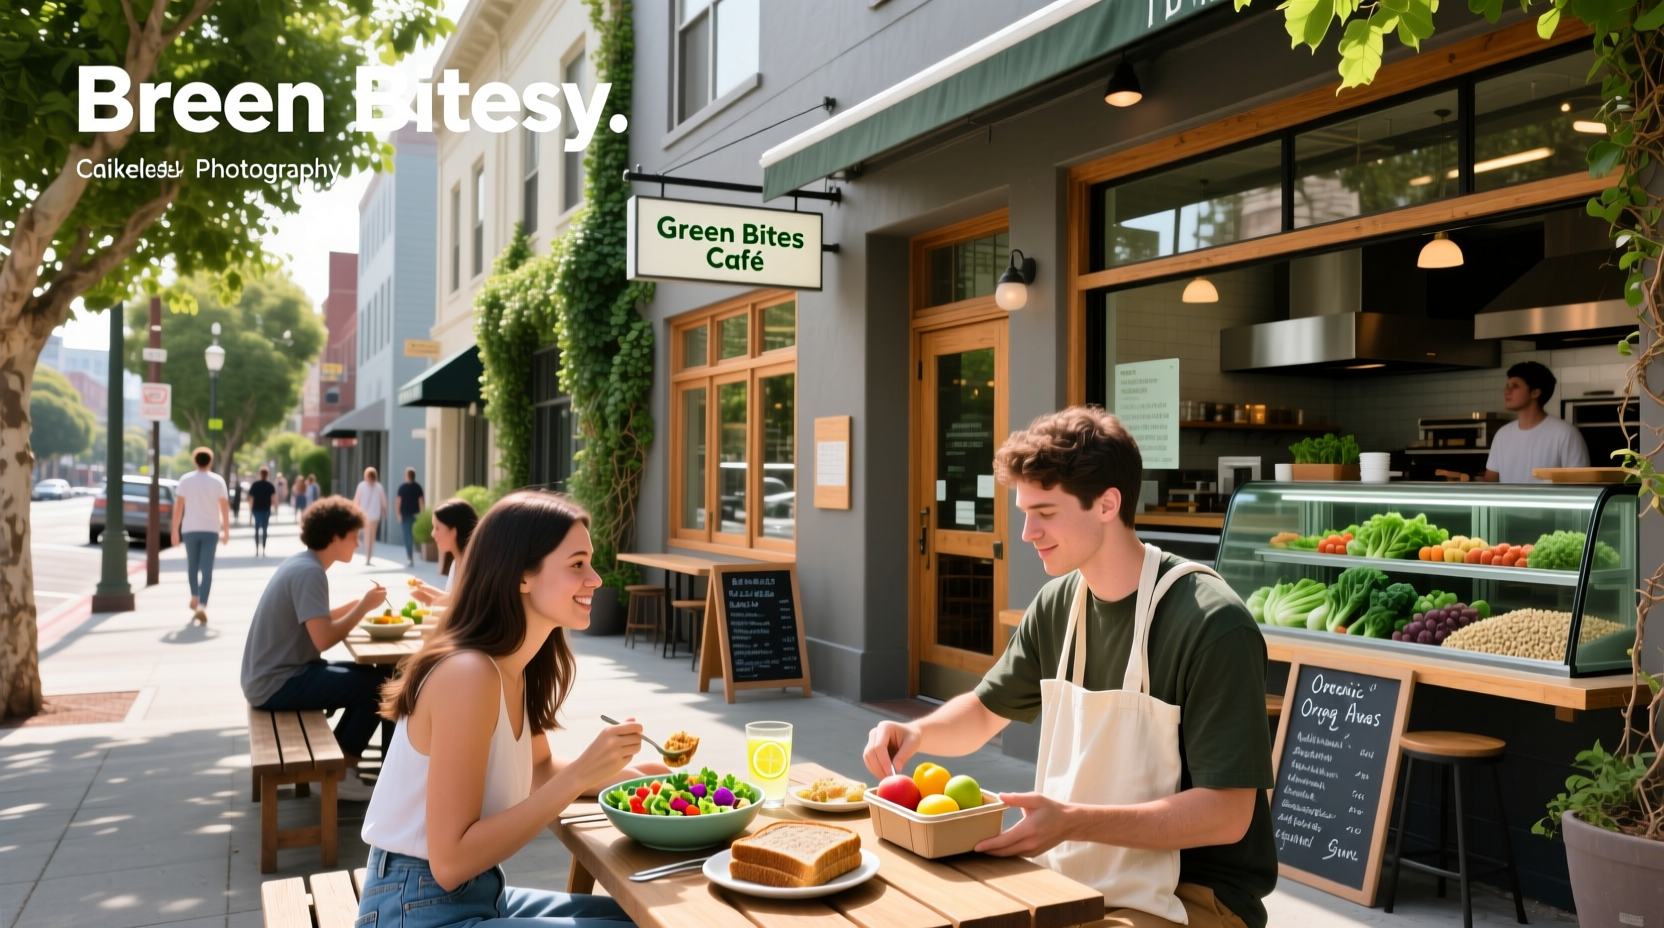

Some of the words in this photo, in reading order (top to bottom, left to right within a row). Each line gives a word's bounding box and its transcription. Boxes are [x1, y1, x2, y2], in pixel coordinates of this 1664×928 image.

[657, 215, 735, 243] Green
[742, 223, 804, 249] Bites
[706, 246, 764, 271] Café
